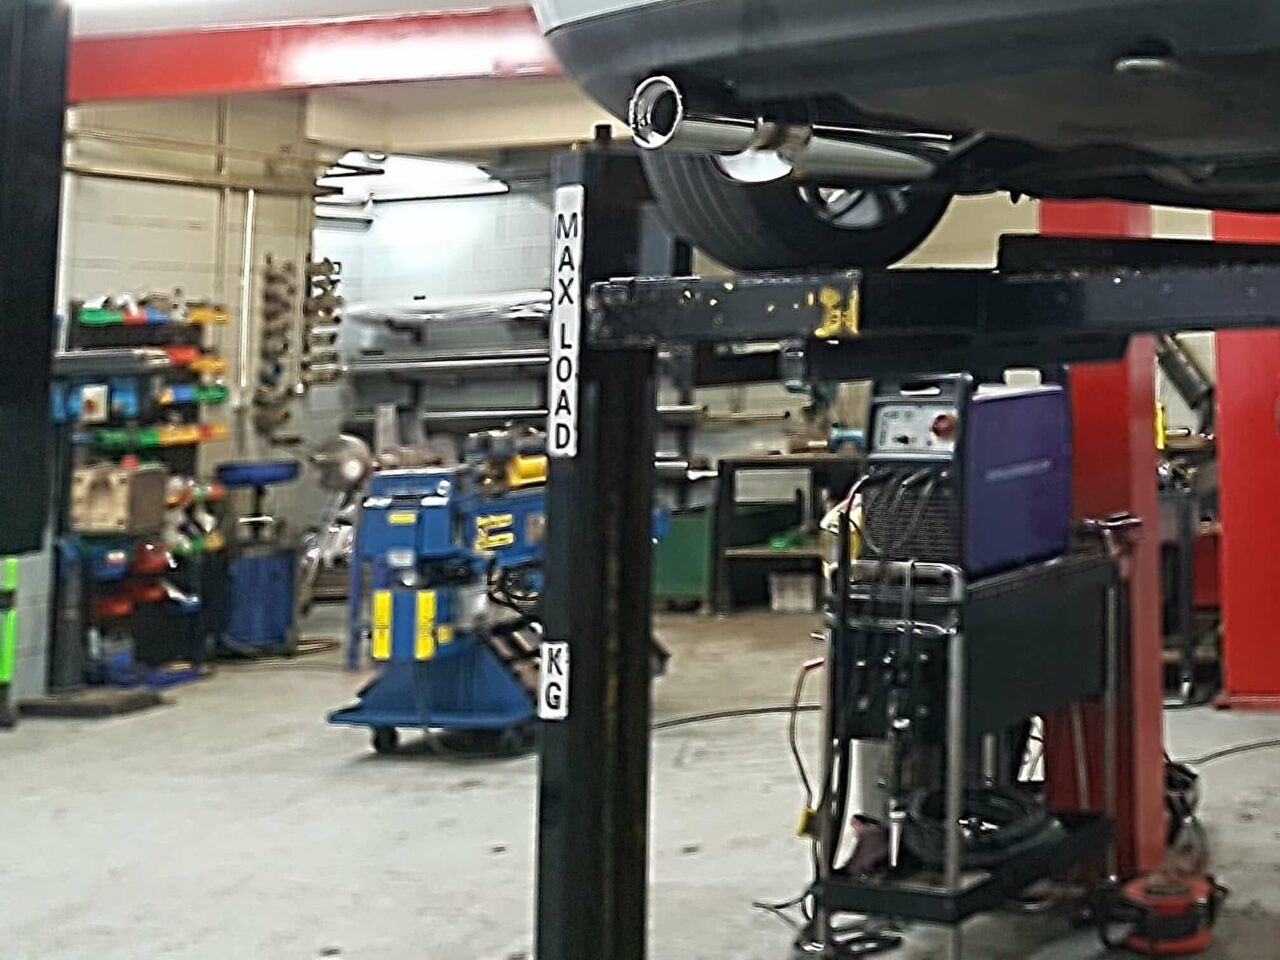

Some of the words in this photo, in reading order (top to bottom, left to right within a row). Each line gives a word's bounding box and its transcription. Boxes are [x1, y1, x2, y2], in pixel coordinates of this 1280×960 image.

[555, 211, 579, 306] MAX
[554, 322, 574, 450] LOAD
[545, 647, 563, 711] KG
